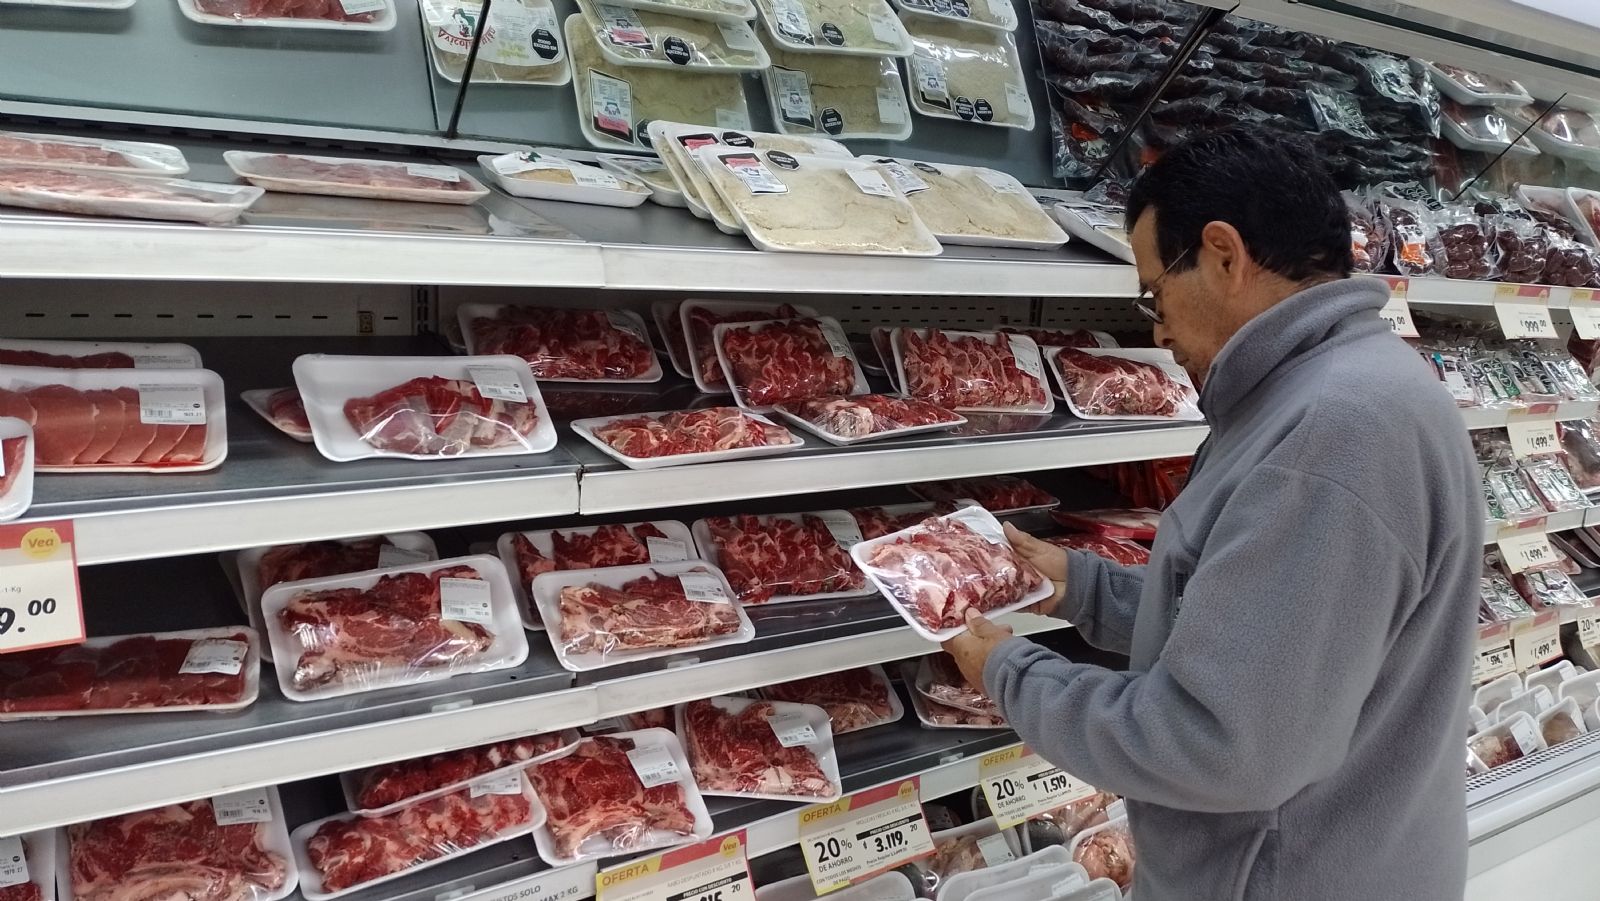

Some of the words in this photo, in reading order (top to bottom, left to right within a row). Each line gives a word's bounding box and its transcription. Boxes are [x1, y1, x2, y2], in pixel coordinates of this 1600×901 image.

[28, 538, 54, 548] Vea
[28, 598, 56, 616] 00
[984, 751, 1015, 766] OFERTA
[804, 804, 842, 823] OFERTA
[910, 824, 918, 832] 20
[723, 841, 737, 851] Vea
[828, 856, 853, 870] AHORRO
[602, 863, 649, 886] OFERTA
[520, 885, 541, 898] SOLO
[732, 884, 740, 893] 20
